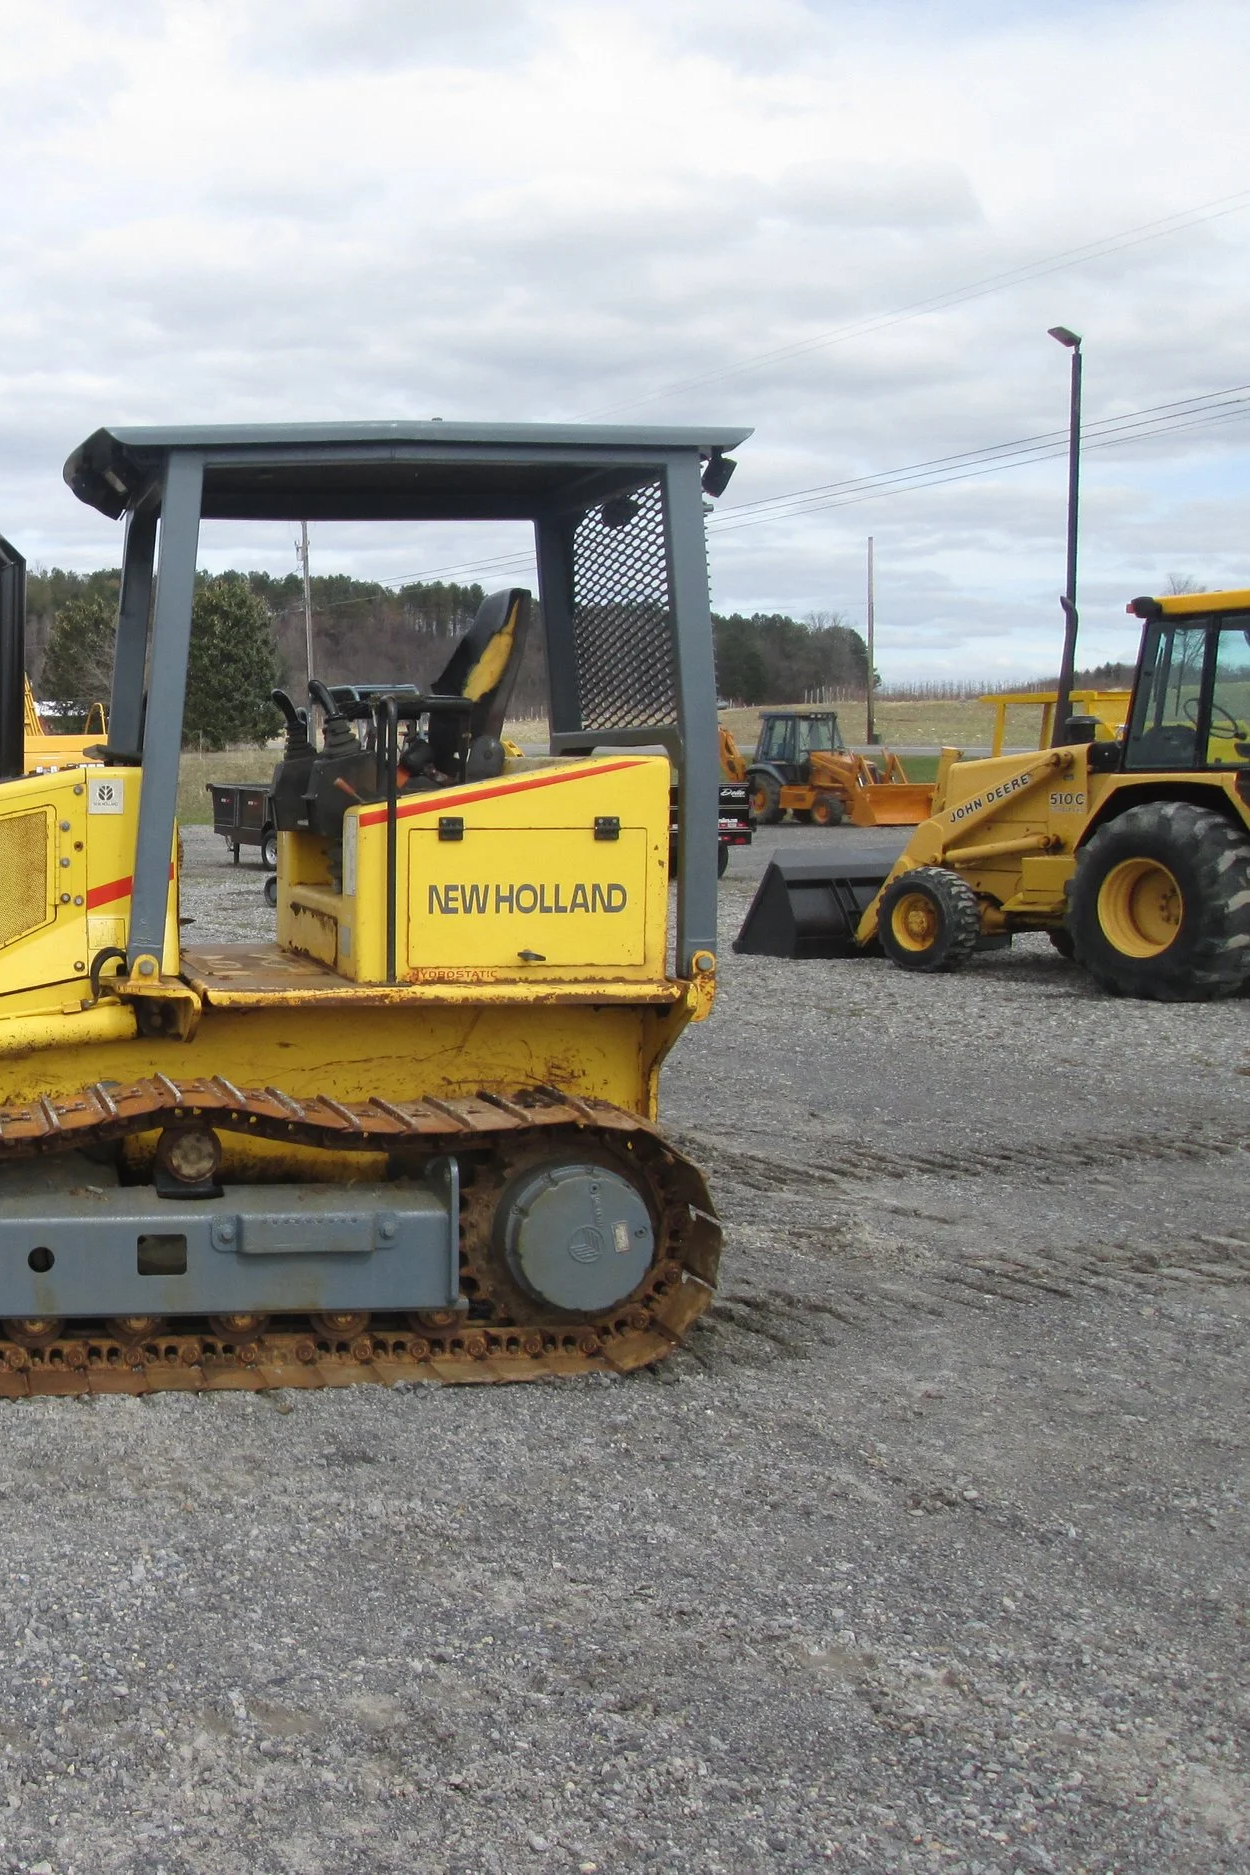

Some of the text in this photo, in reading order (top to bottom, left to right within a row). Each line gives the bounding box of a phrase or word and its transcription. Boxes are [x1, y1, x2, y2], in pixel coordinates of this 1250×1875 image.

[950, 773, 1030, 823] JOHN DEERE
[428, 883, 628, 914] NEW HOLLAND
[412, 970, 498, 978] HYDROSTATIC
